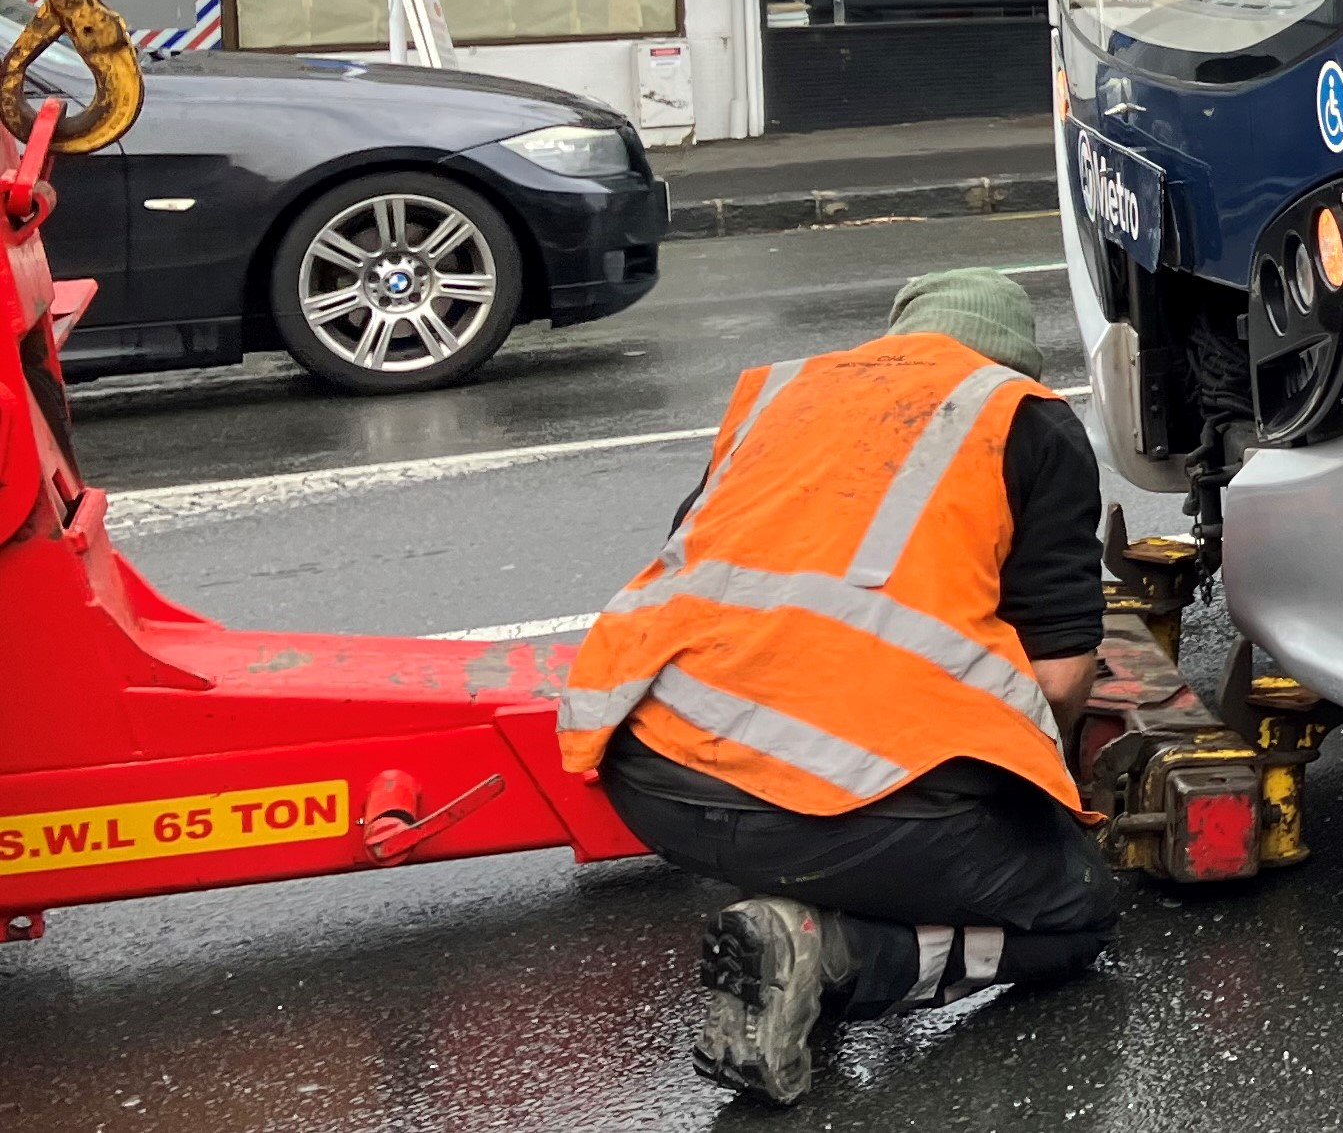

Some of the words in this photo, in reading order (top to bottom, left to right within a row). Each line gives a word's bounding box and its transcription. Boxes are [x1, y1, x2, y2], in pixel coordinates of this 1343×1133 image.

[0, 820, 135, 861] S.W.L
[153, 808, 214, 843] 65
[230, 794, 338, 834] TON
